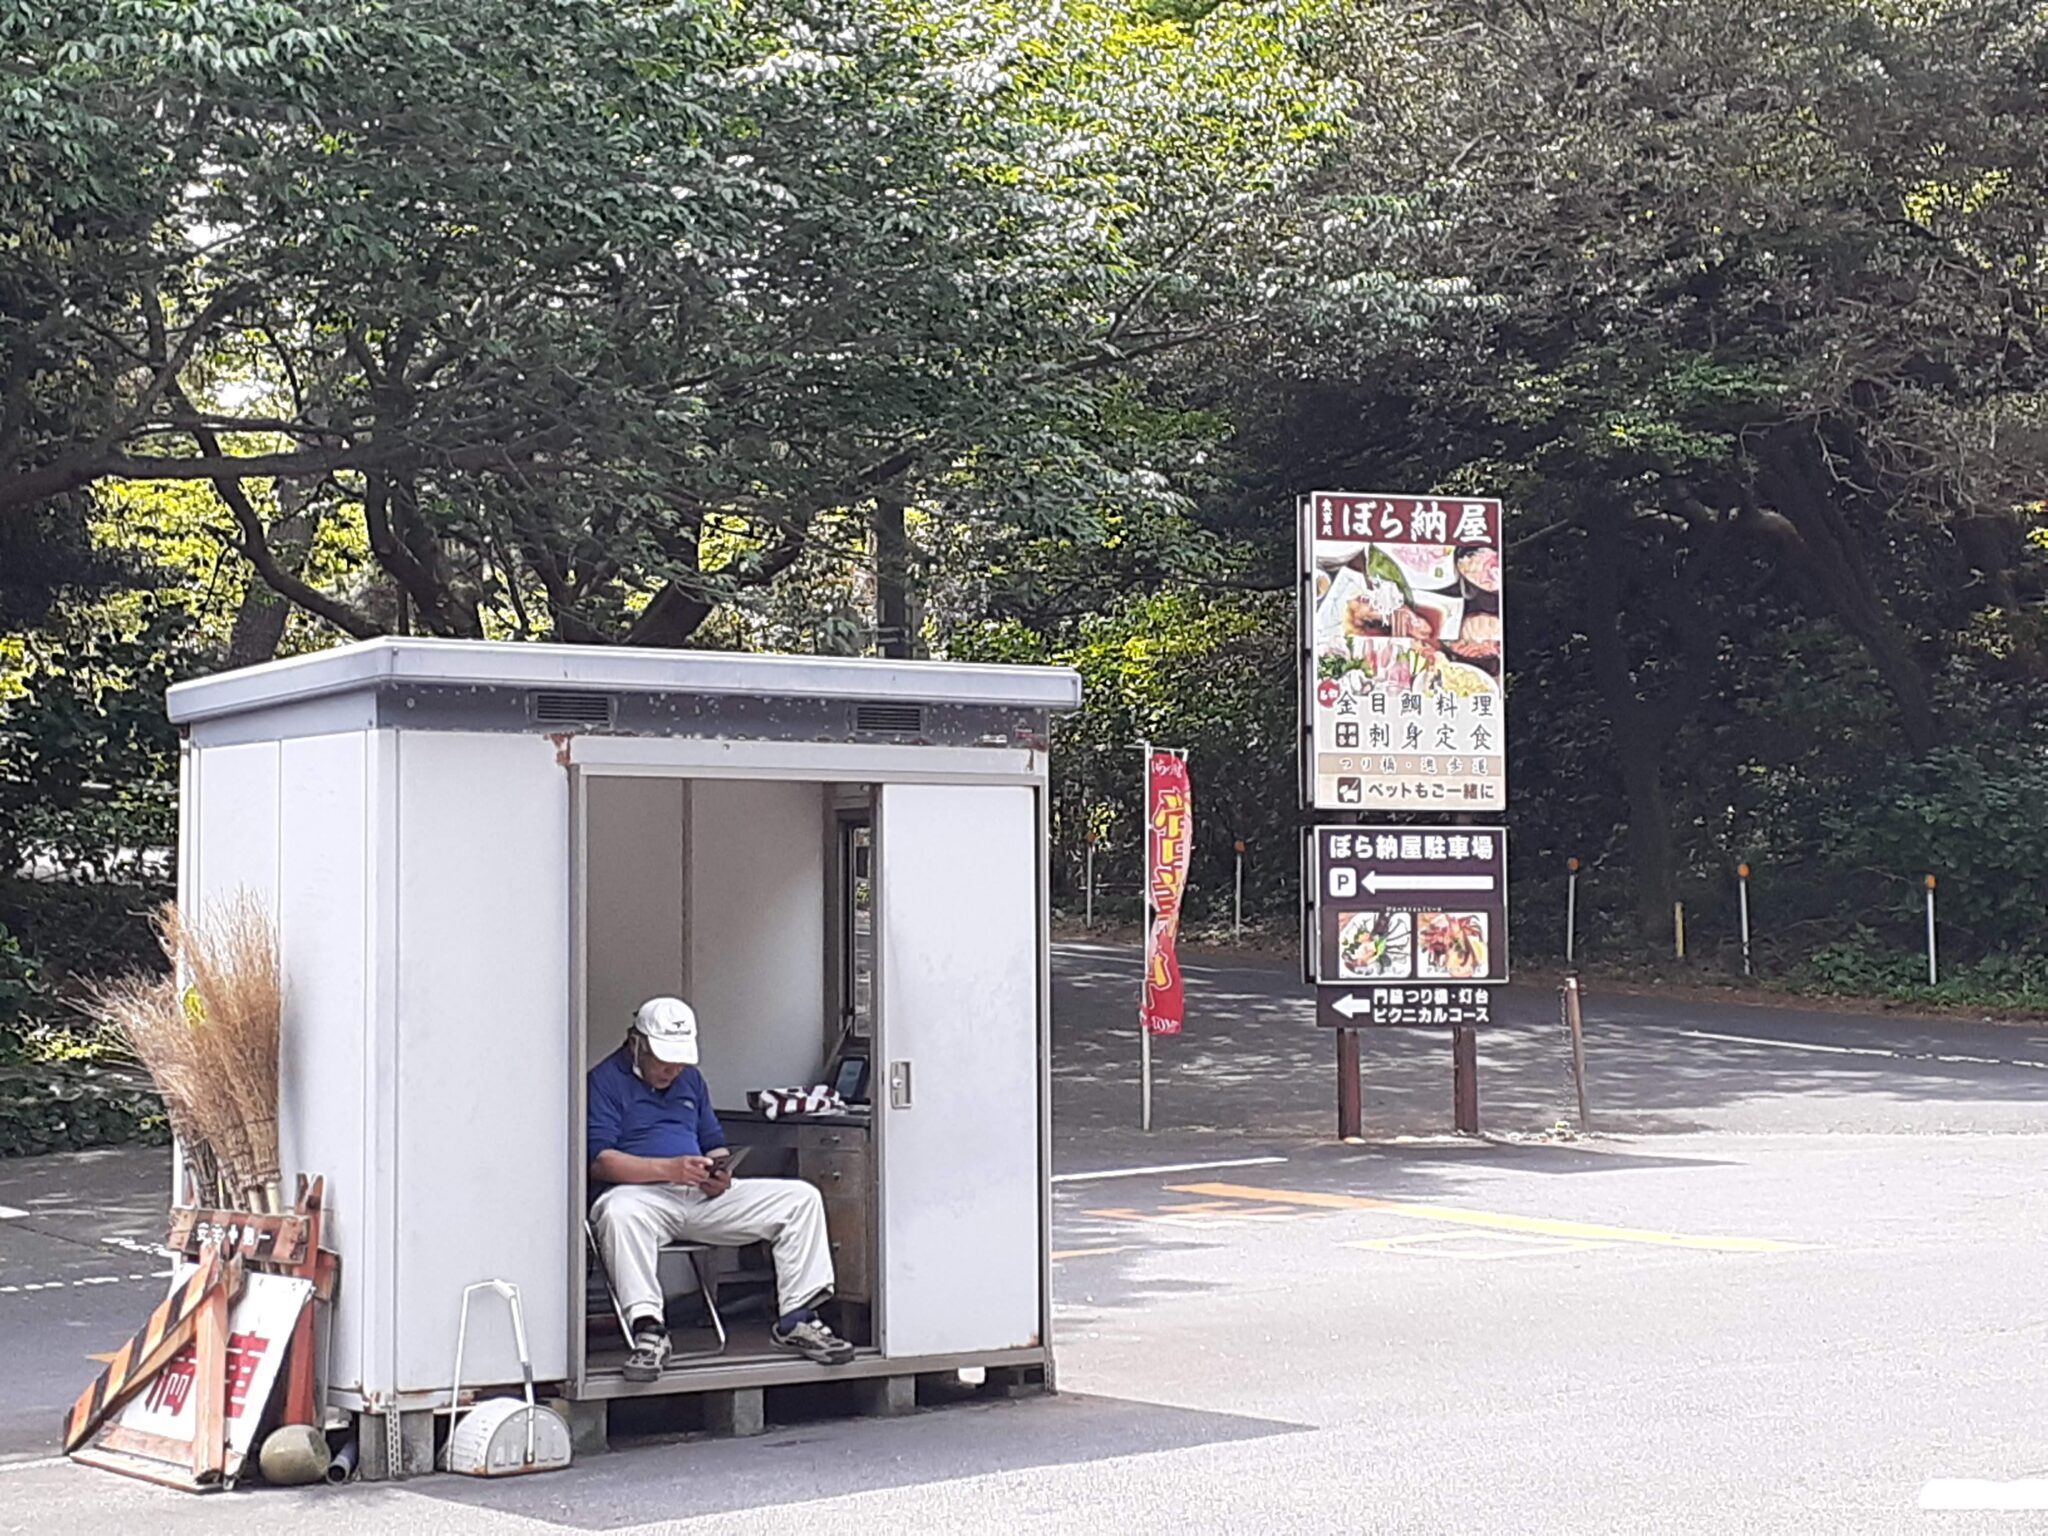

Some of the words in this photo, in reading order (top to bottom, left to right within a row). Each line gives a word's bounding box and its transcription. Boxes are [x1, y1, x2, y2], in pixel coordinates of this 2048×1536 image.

[1342, 501, 1493, 544] ぼら納屋
[1336, 690, 1494, 718] 金目鯛料理
[1368, 721, 1493, 751] 刺身定食
[1368, 781, 1495, 800] ペットもご一緒に
[1329, 834, 1494, 860] ぼら納屋駐車場
